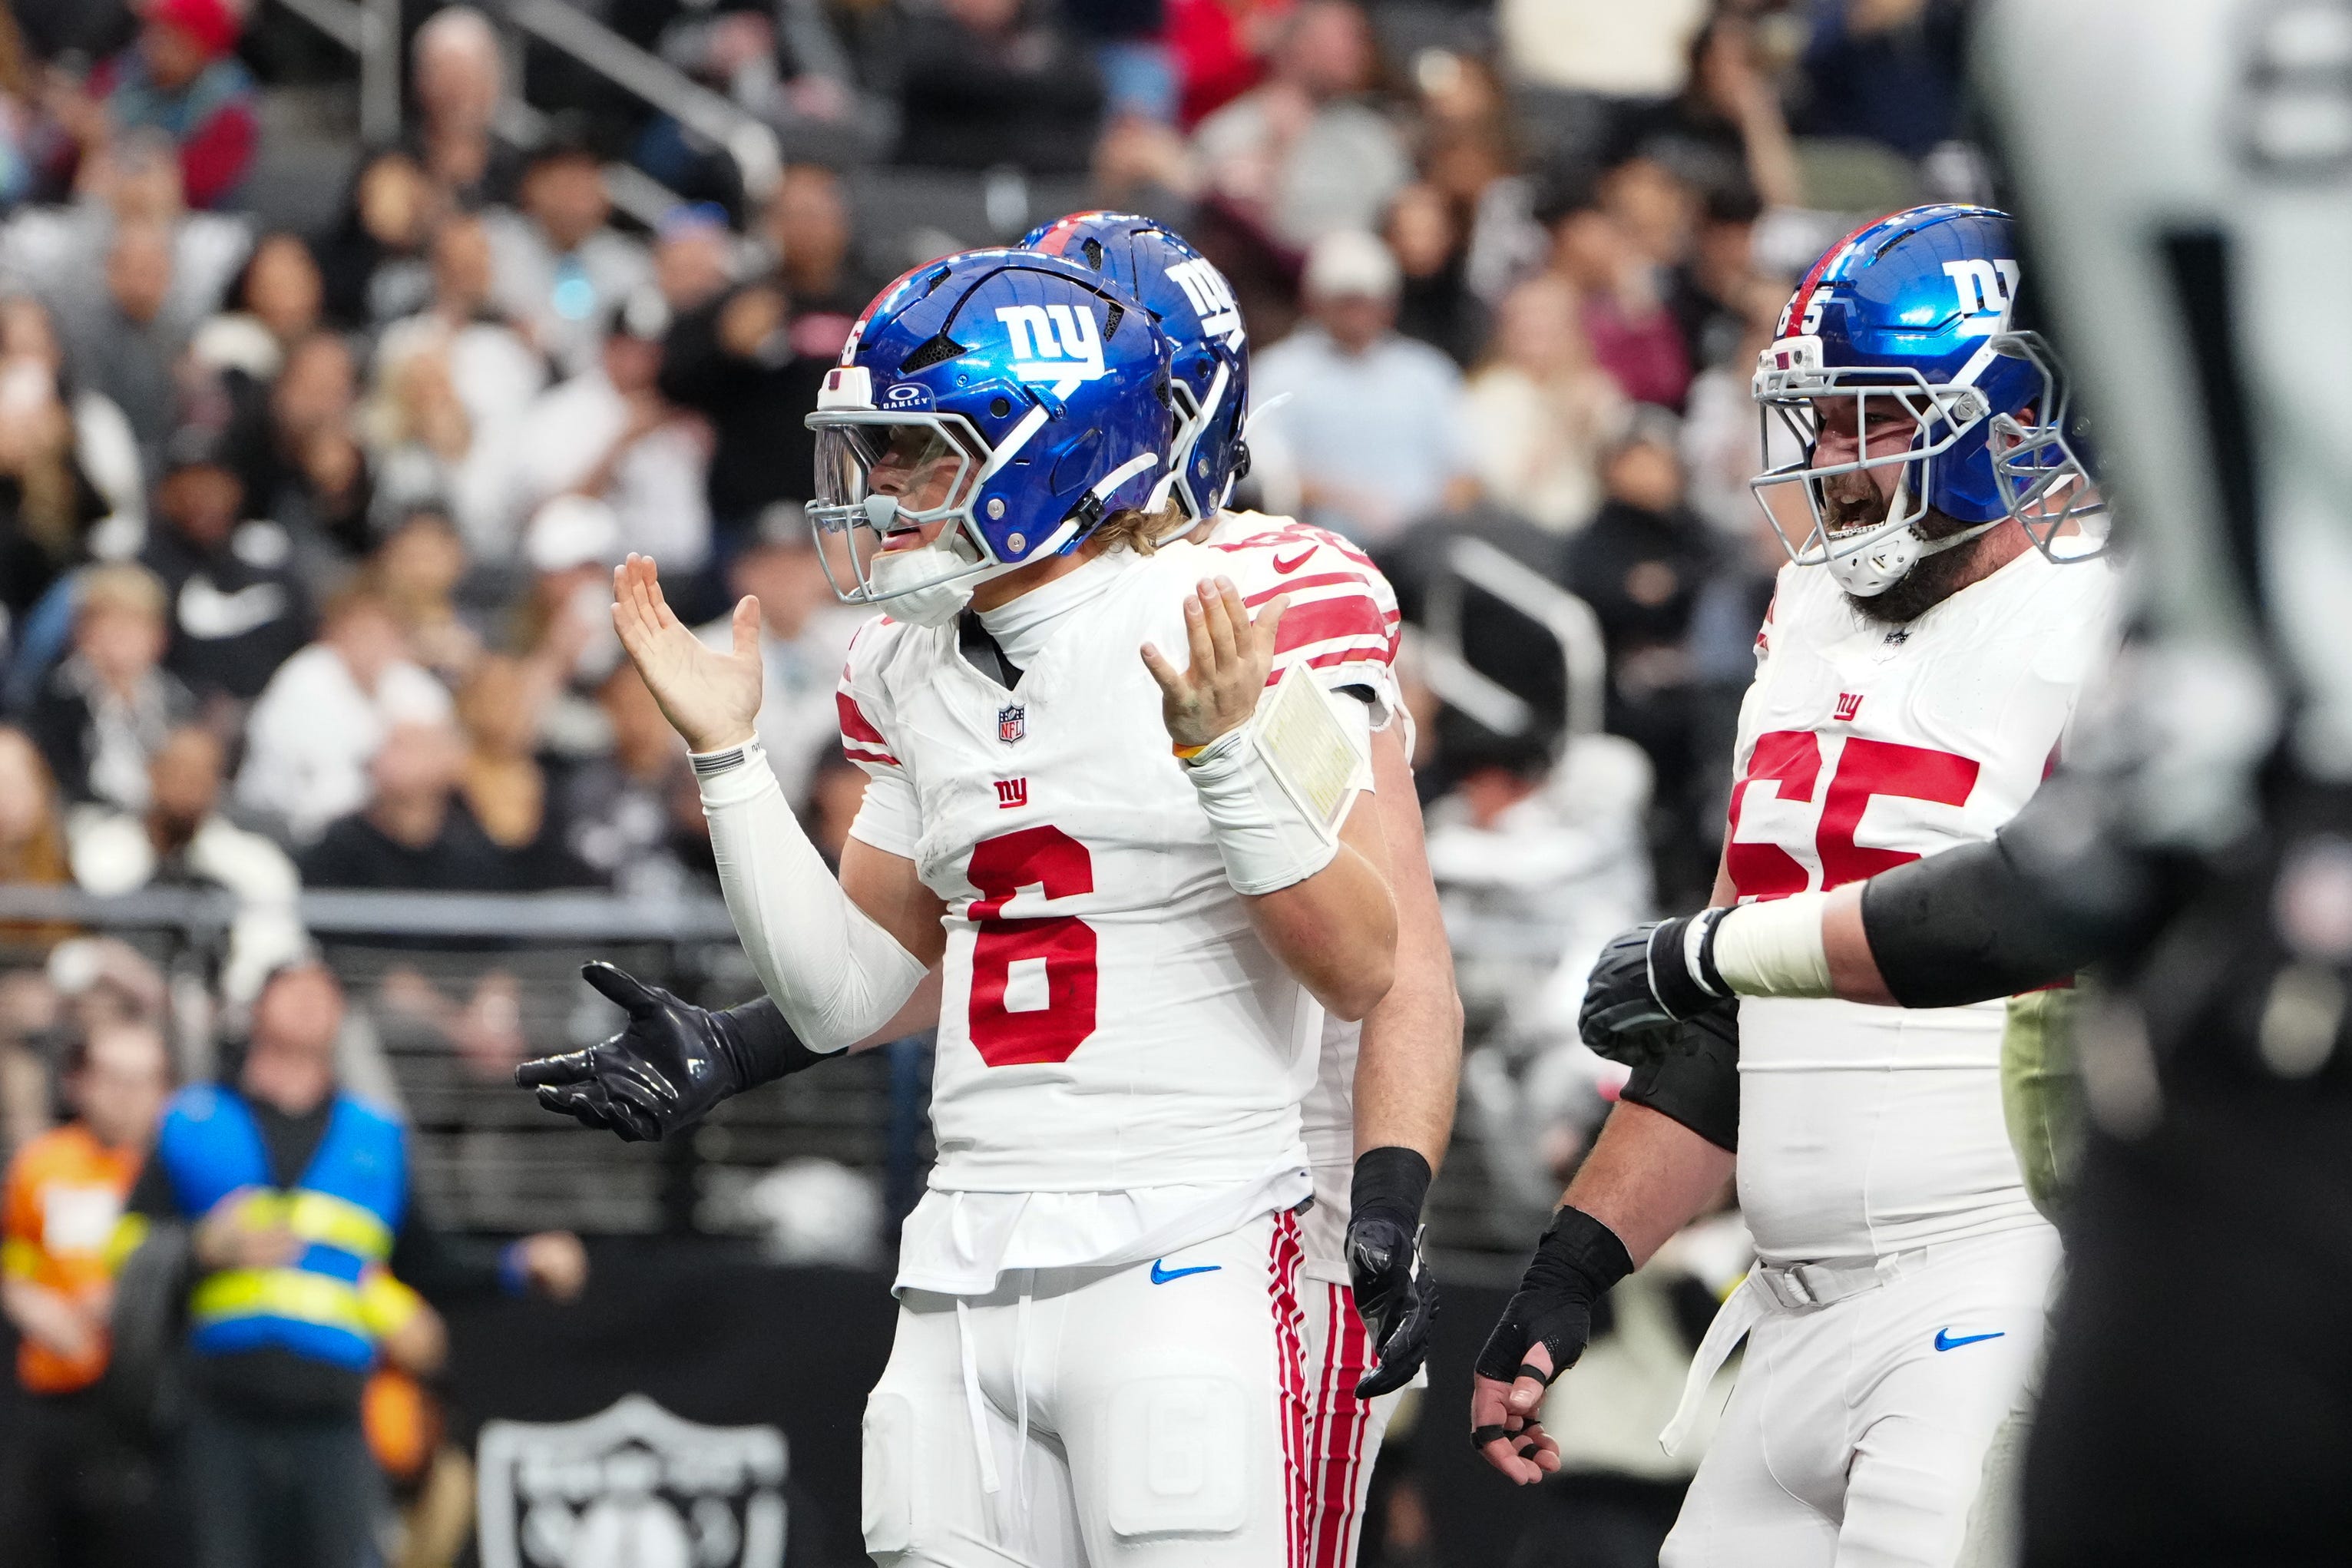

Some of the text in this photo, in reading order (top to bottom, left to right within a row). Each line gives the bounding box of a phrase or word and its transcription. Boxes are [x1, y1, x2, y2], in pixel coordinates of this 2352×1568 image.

[1163, 257, 1242, 338] ny
[842, 319, 867, 367] 6
[995, 304, 1106, 382] ny
[883, 397, 928, 409] OAKLEY
[1833, 693, 1864, 721] ny
[1001, 721, 1021, 739] NFL
[993, 777, 1027, 809] ny
[967, 824, 1098, 1067] 6
